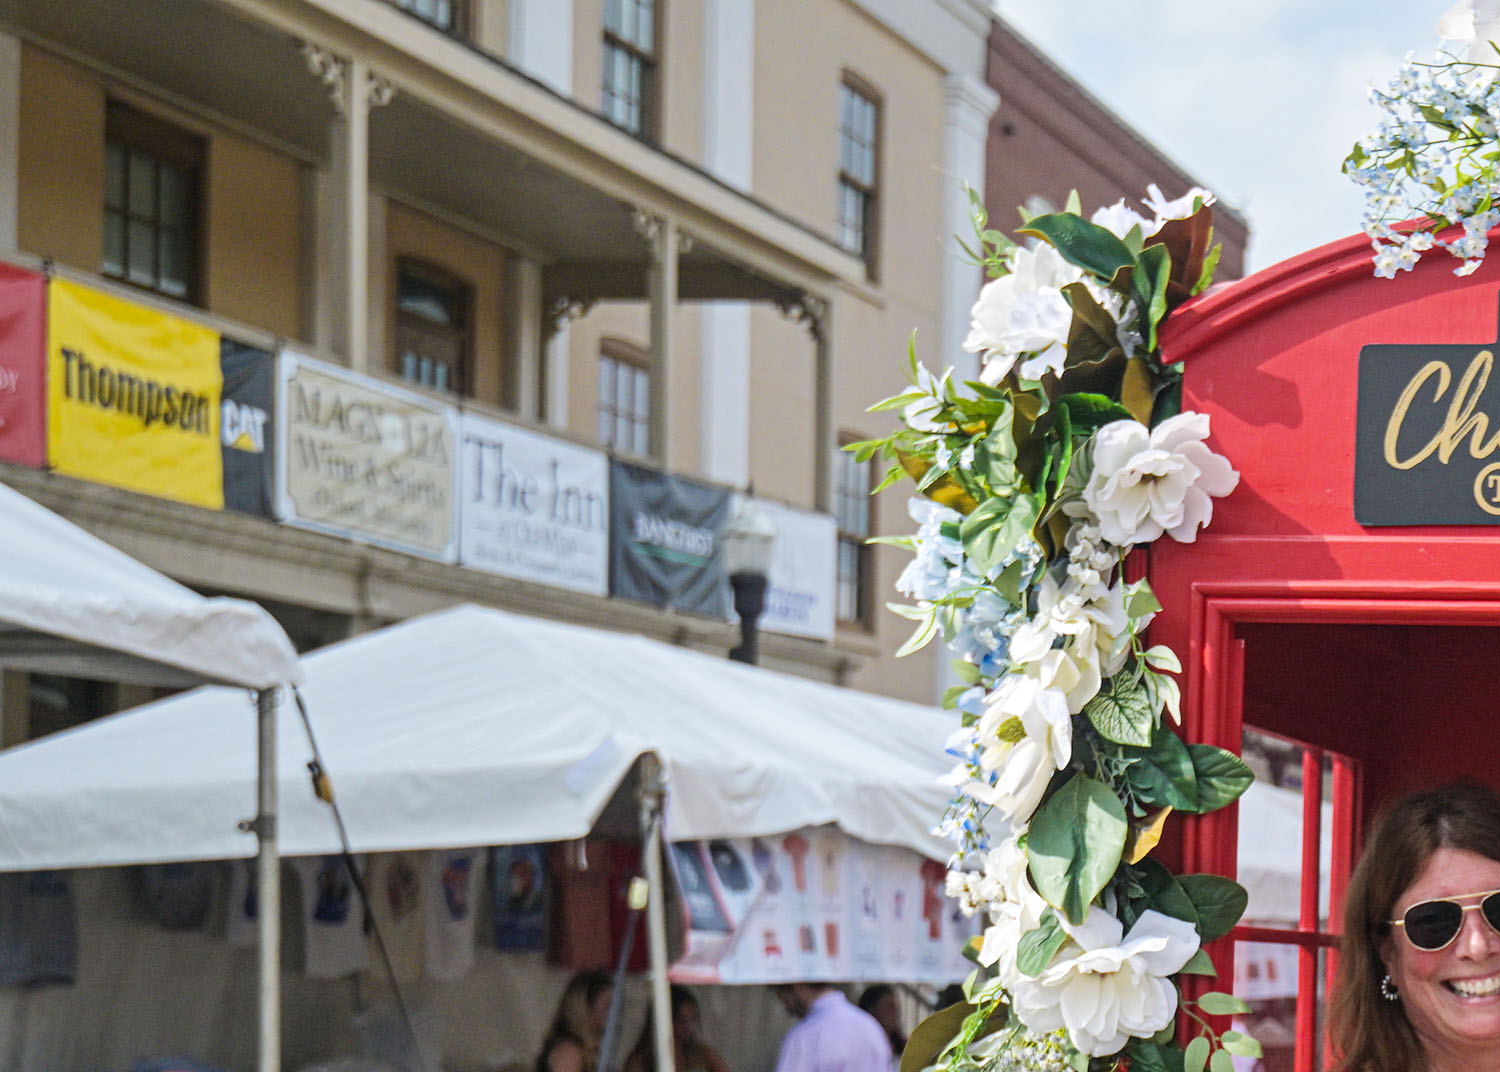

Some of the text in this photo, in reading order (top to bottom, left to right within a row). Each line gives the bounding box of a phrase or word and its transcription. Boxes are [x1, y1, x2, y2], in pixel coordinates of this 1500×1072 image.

[60, 344, 211, 436] Thompson
[220, 398, 269, 454] CAT
[463, 433, 538, 516] The
[549, 456, 606, 534] Inn
